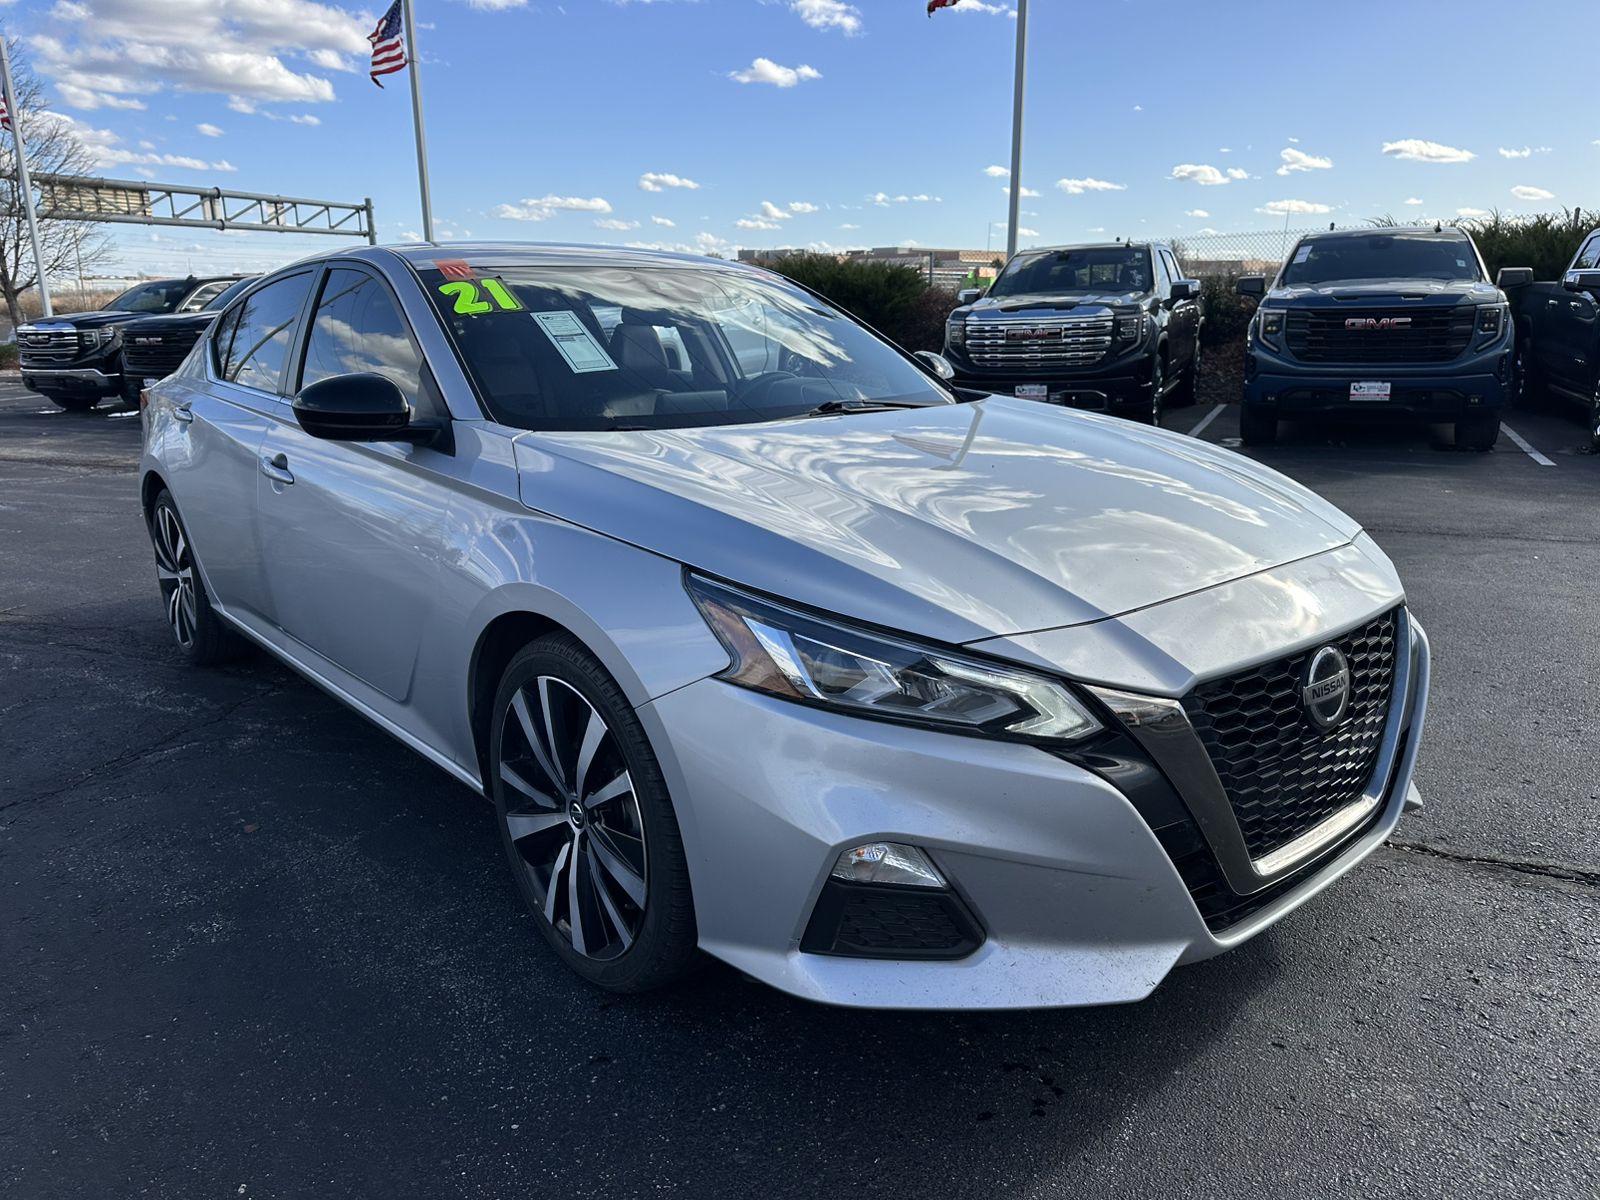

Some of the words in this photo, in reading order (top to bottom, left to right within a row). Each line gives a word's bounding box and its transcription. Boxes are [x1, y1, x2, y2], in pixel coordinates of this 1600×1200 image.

[438, 278, 523, 314] 21
[1345, 317, 1412, 330] GMC
[1007, 329, 1061, 340] GMC
[1311, 675, 1346, 700] NISSAN
